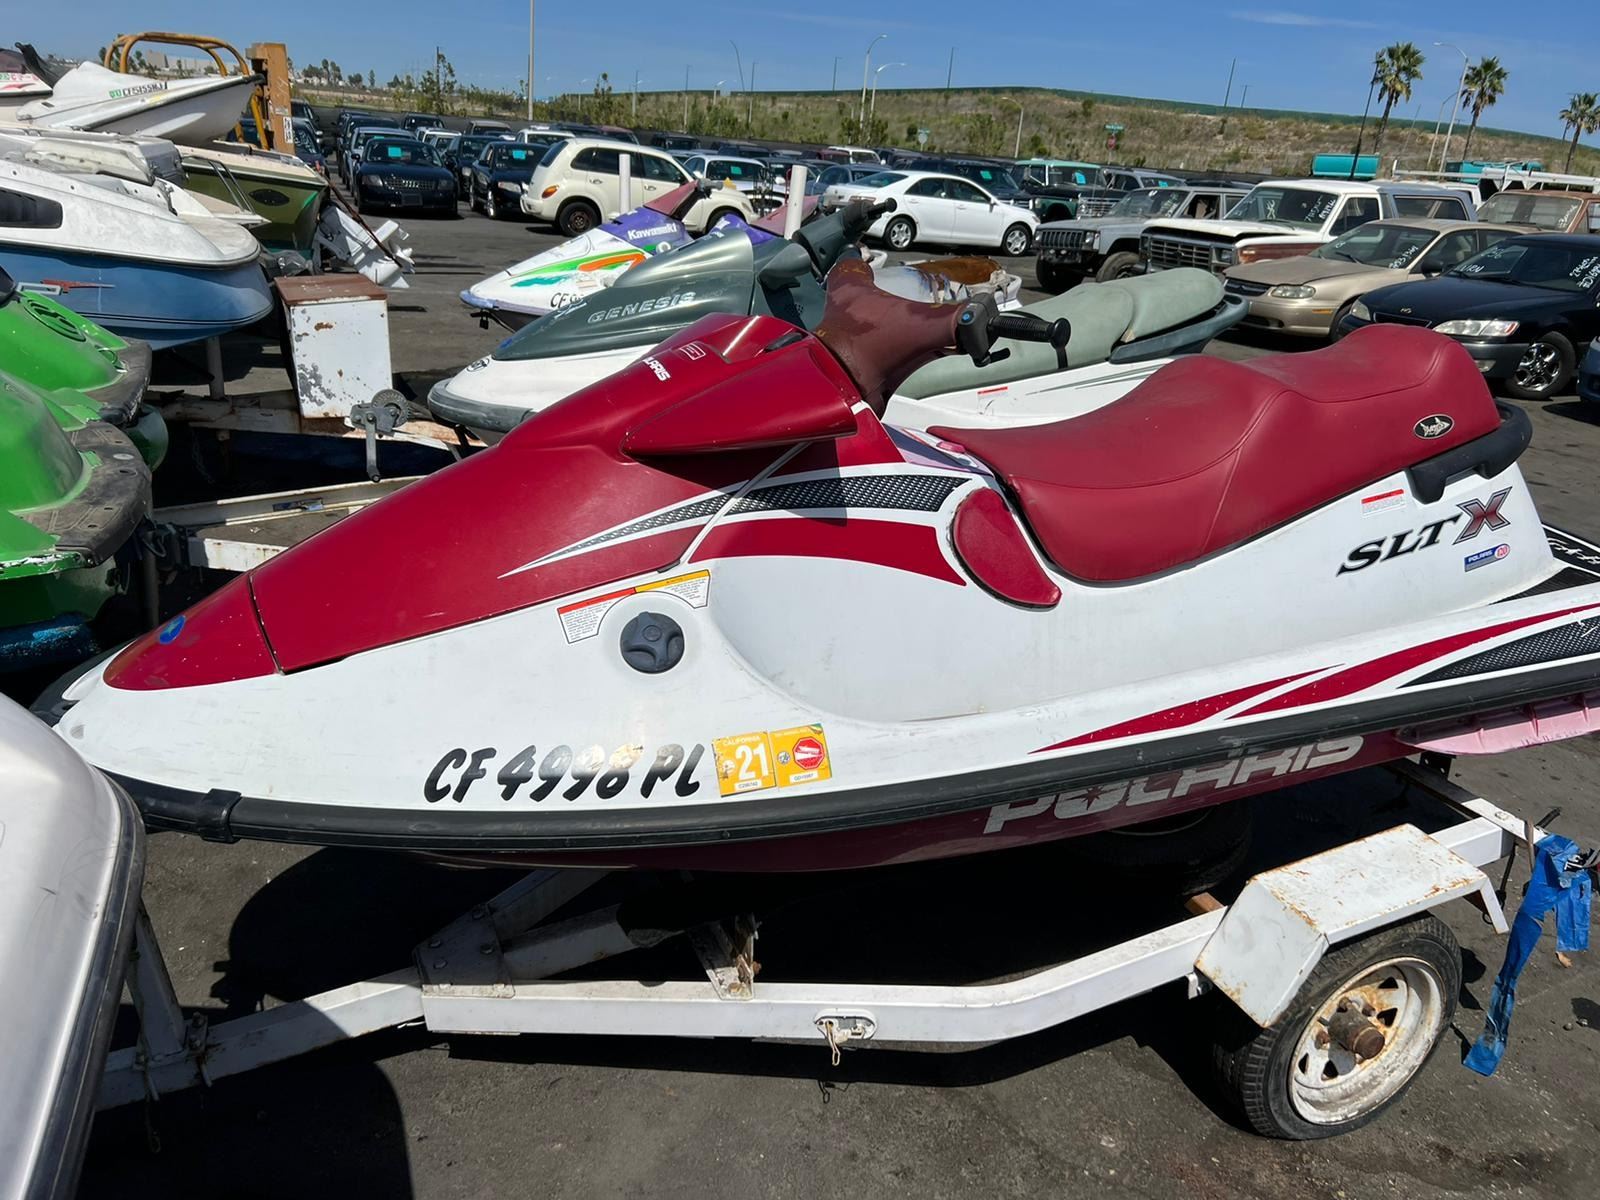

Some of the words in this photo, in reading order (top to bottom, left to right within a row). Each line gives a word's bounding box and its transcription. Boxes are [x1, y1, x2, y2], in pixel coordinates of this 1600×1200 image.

[627, 222, 677, 240] Kawasaki
[587, 291, 697, 324] GENESIS
[424, 746, 497, 804] CF
[640, 743, 706, 800] PL
[735, 742, 769, 781] 21
